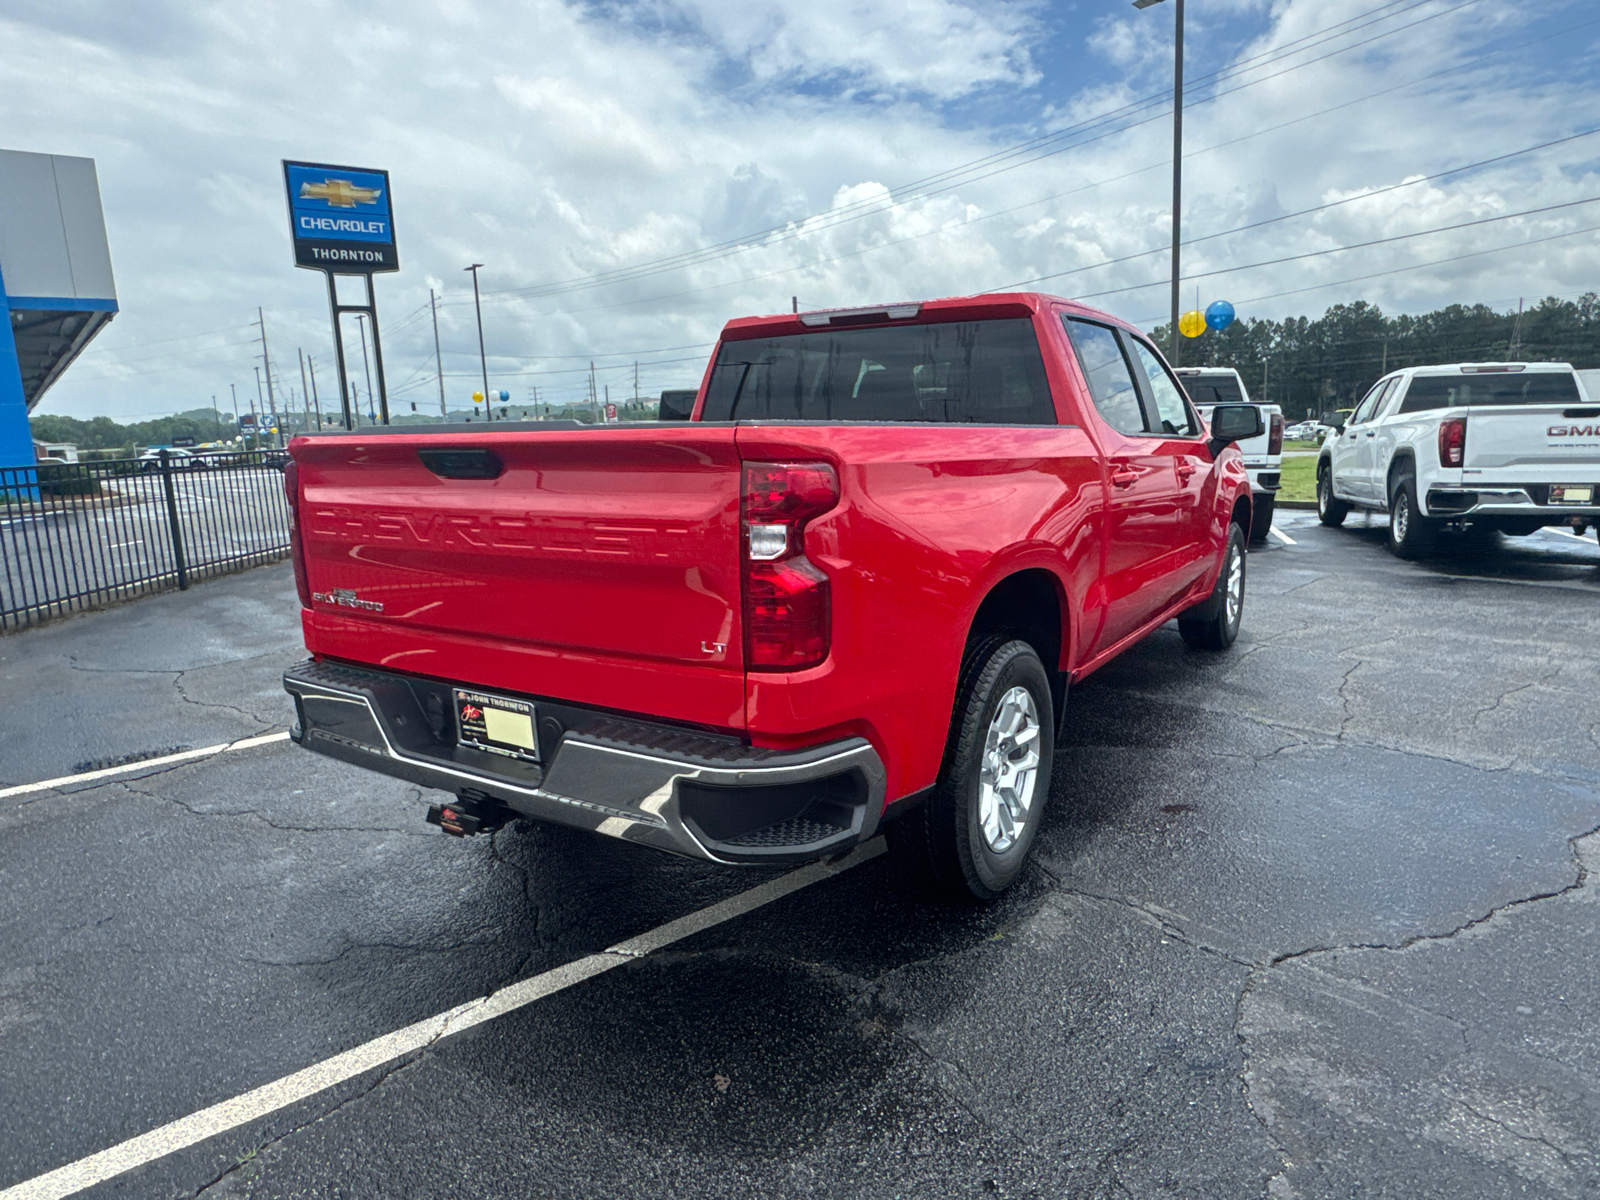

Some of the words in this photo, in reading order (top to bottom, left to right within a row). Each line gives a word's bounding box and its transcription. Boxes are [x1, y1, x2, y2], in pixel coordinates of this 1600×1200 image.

[301, 217, 385, 233] CHEVROLET
[312, 248, 383, 262] THORNTON
[313, 591, 384, 612] SILVERADO
[701, 640, 728, 654] LT
[468, 694, 489, 704] JOHN
[490, 698, 530, 712] THORNTON
